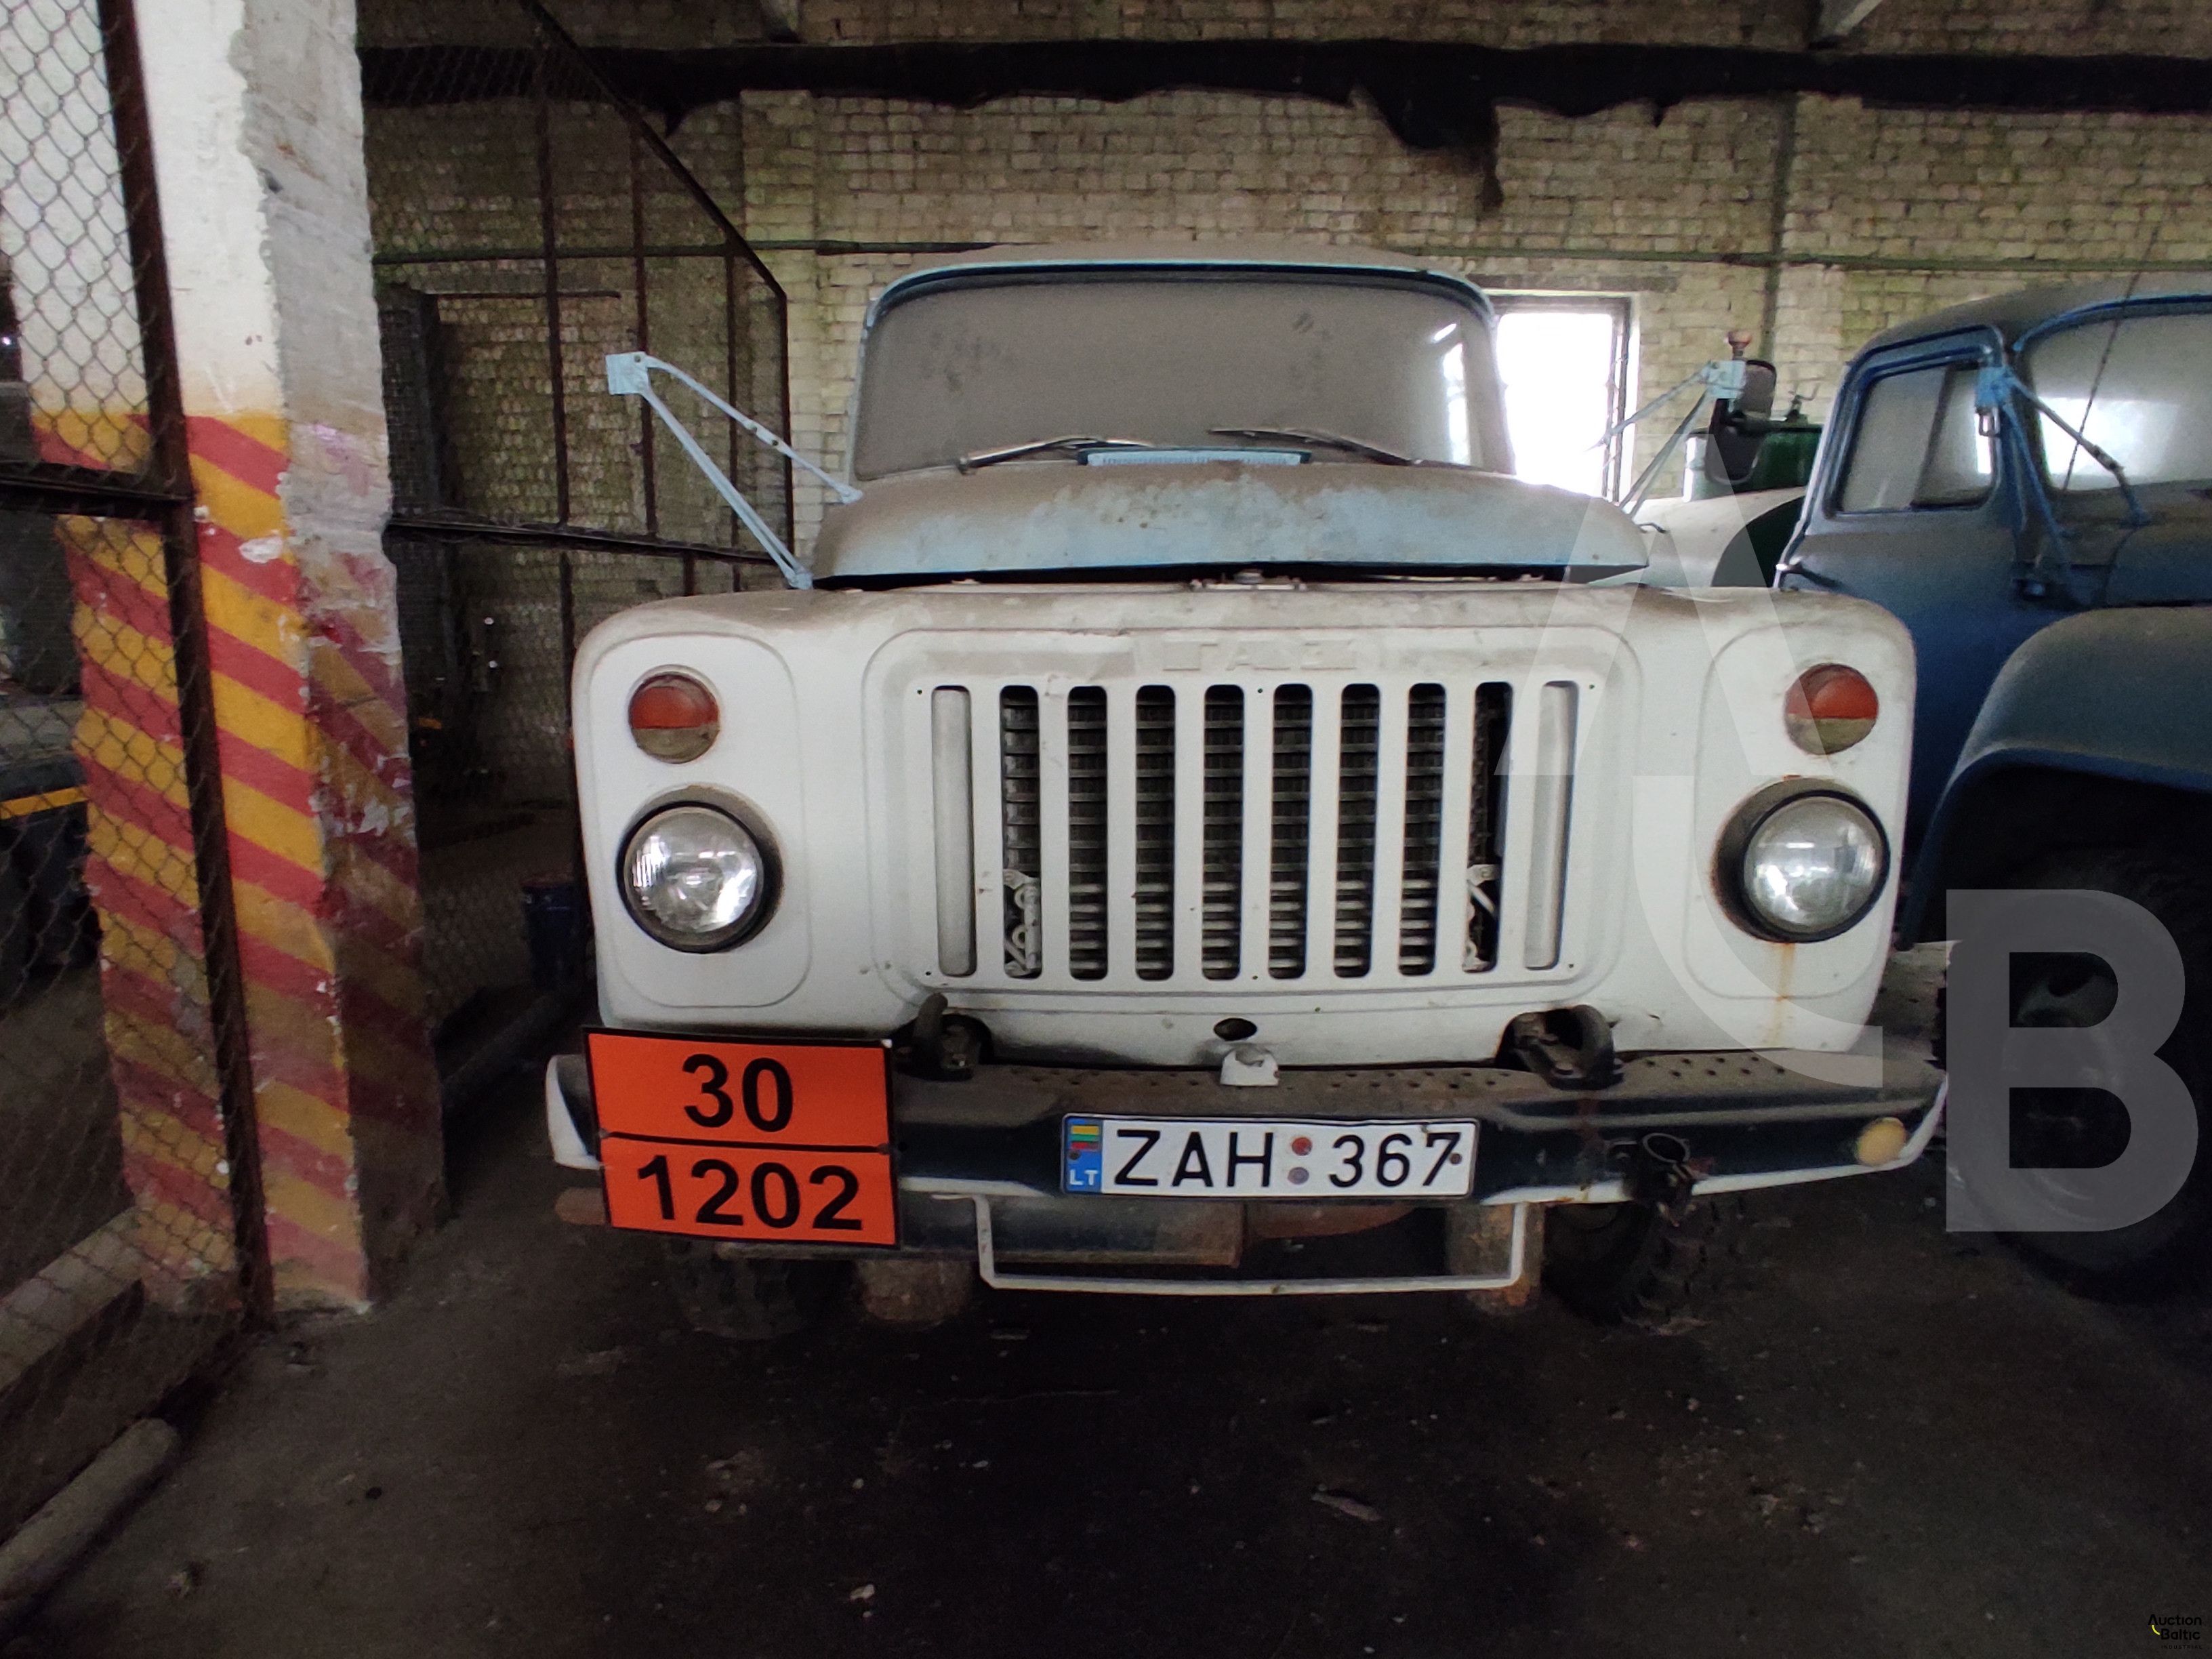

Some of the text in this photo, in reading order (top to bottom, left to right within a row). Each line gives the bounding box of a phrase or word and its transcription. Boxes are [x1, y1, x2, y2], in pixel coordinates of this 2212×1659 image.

[682, 1052, 794, 1132] 30
[637, 1154, 863, 1231] 1202
[1069, 1170, 1097, 1186] LT
[1114, 1129, 1461, 1188] ZAH 367
